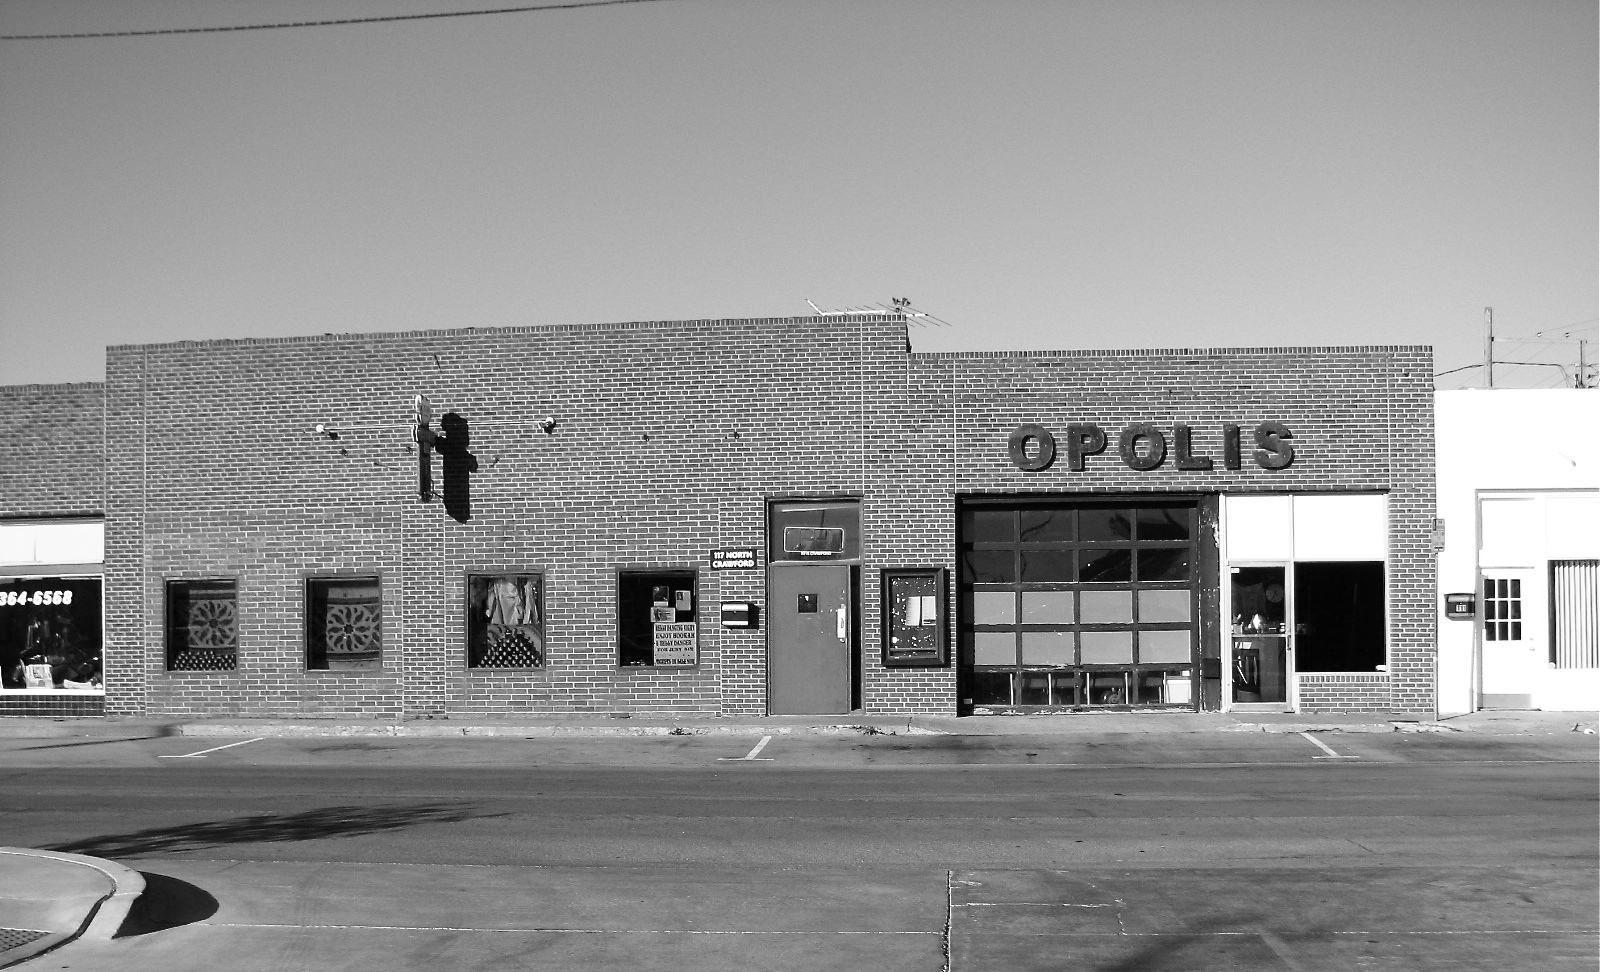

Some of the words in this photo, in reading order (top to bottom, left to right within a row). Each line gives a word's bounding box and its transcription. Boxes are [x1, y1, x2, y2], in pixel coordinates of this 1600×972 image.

[1007, 420, 1294, 471] OPOLIS
[713, 551, 725, 560] 117
[725, 550, 753, 559] NORTH
[712, 560, 755, 568] CRAWFORD
[0, 590, 73, 606] 364-6568
